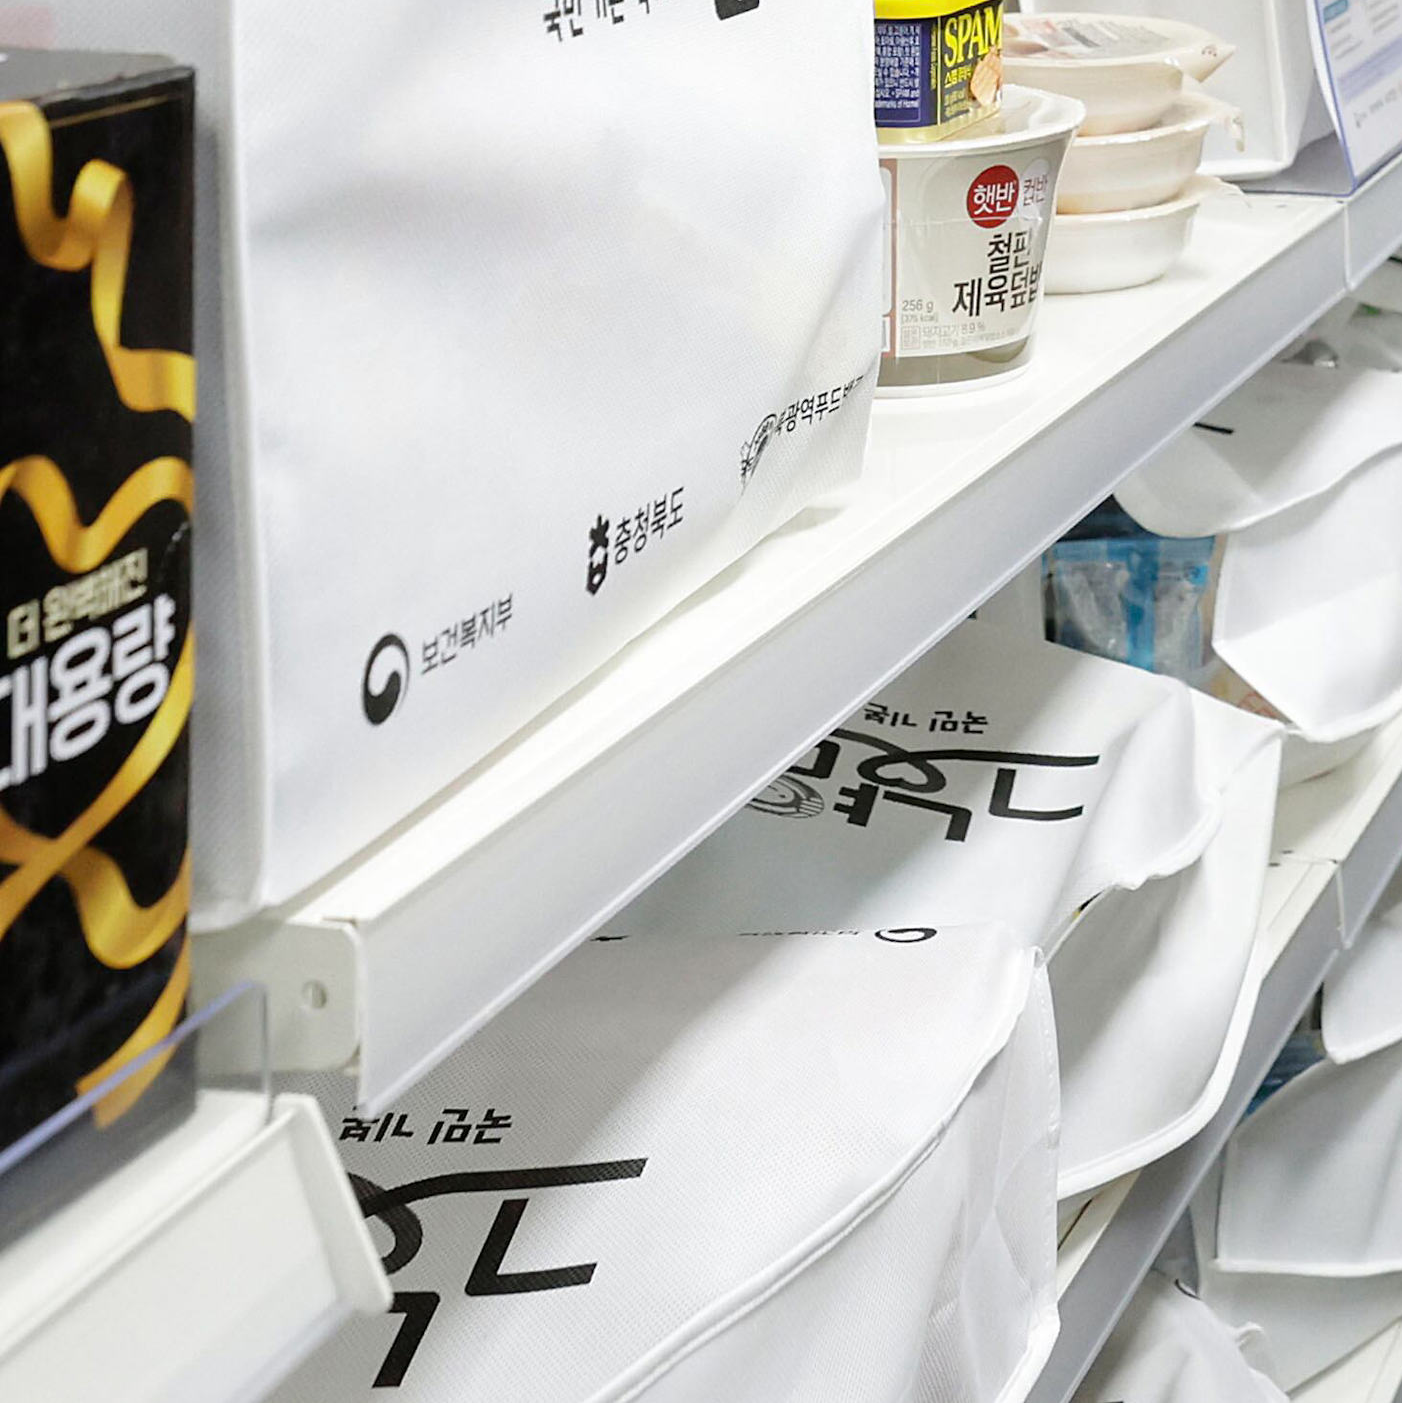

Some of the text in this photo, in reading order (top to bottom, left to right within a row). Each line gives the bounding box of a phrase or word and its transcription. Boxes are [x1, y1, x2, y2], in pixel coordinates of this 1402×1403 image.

[944, 6, 1002, 68] SPAM
[973, 173, 1048, 216] 햇반 컵반
[987, 228, 1032, 276] 철판
[902, 299, 934, 314] 256 g
[952, 260, 1044, 318] 제육덮밥
[614, 486, 684, 565] 충청북도
[7, 599, 40, 660] 더
[421, 593, 513, 675] 보건복지부
[0, 594, 176, 790] 대용량
[863, 702, 989, 736] 국민 기본
[427, 1108, 512, 1145] 국민
